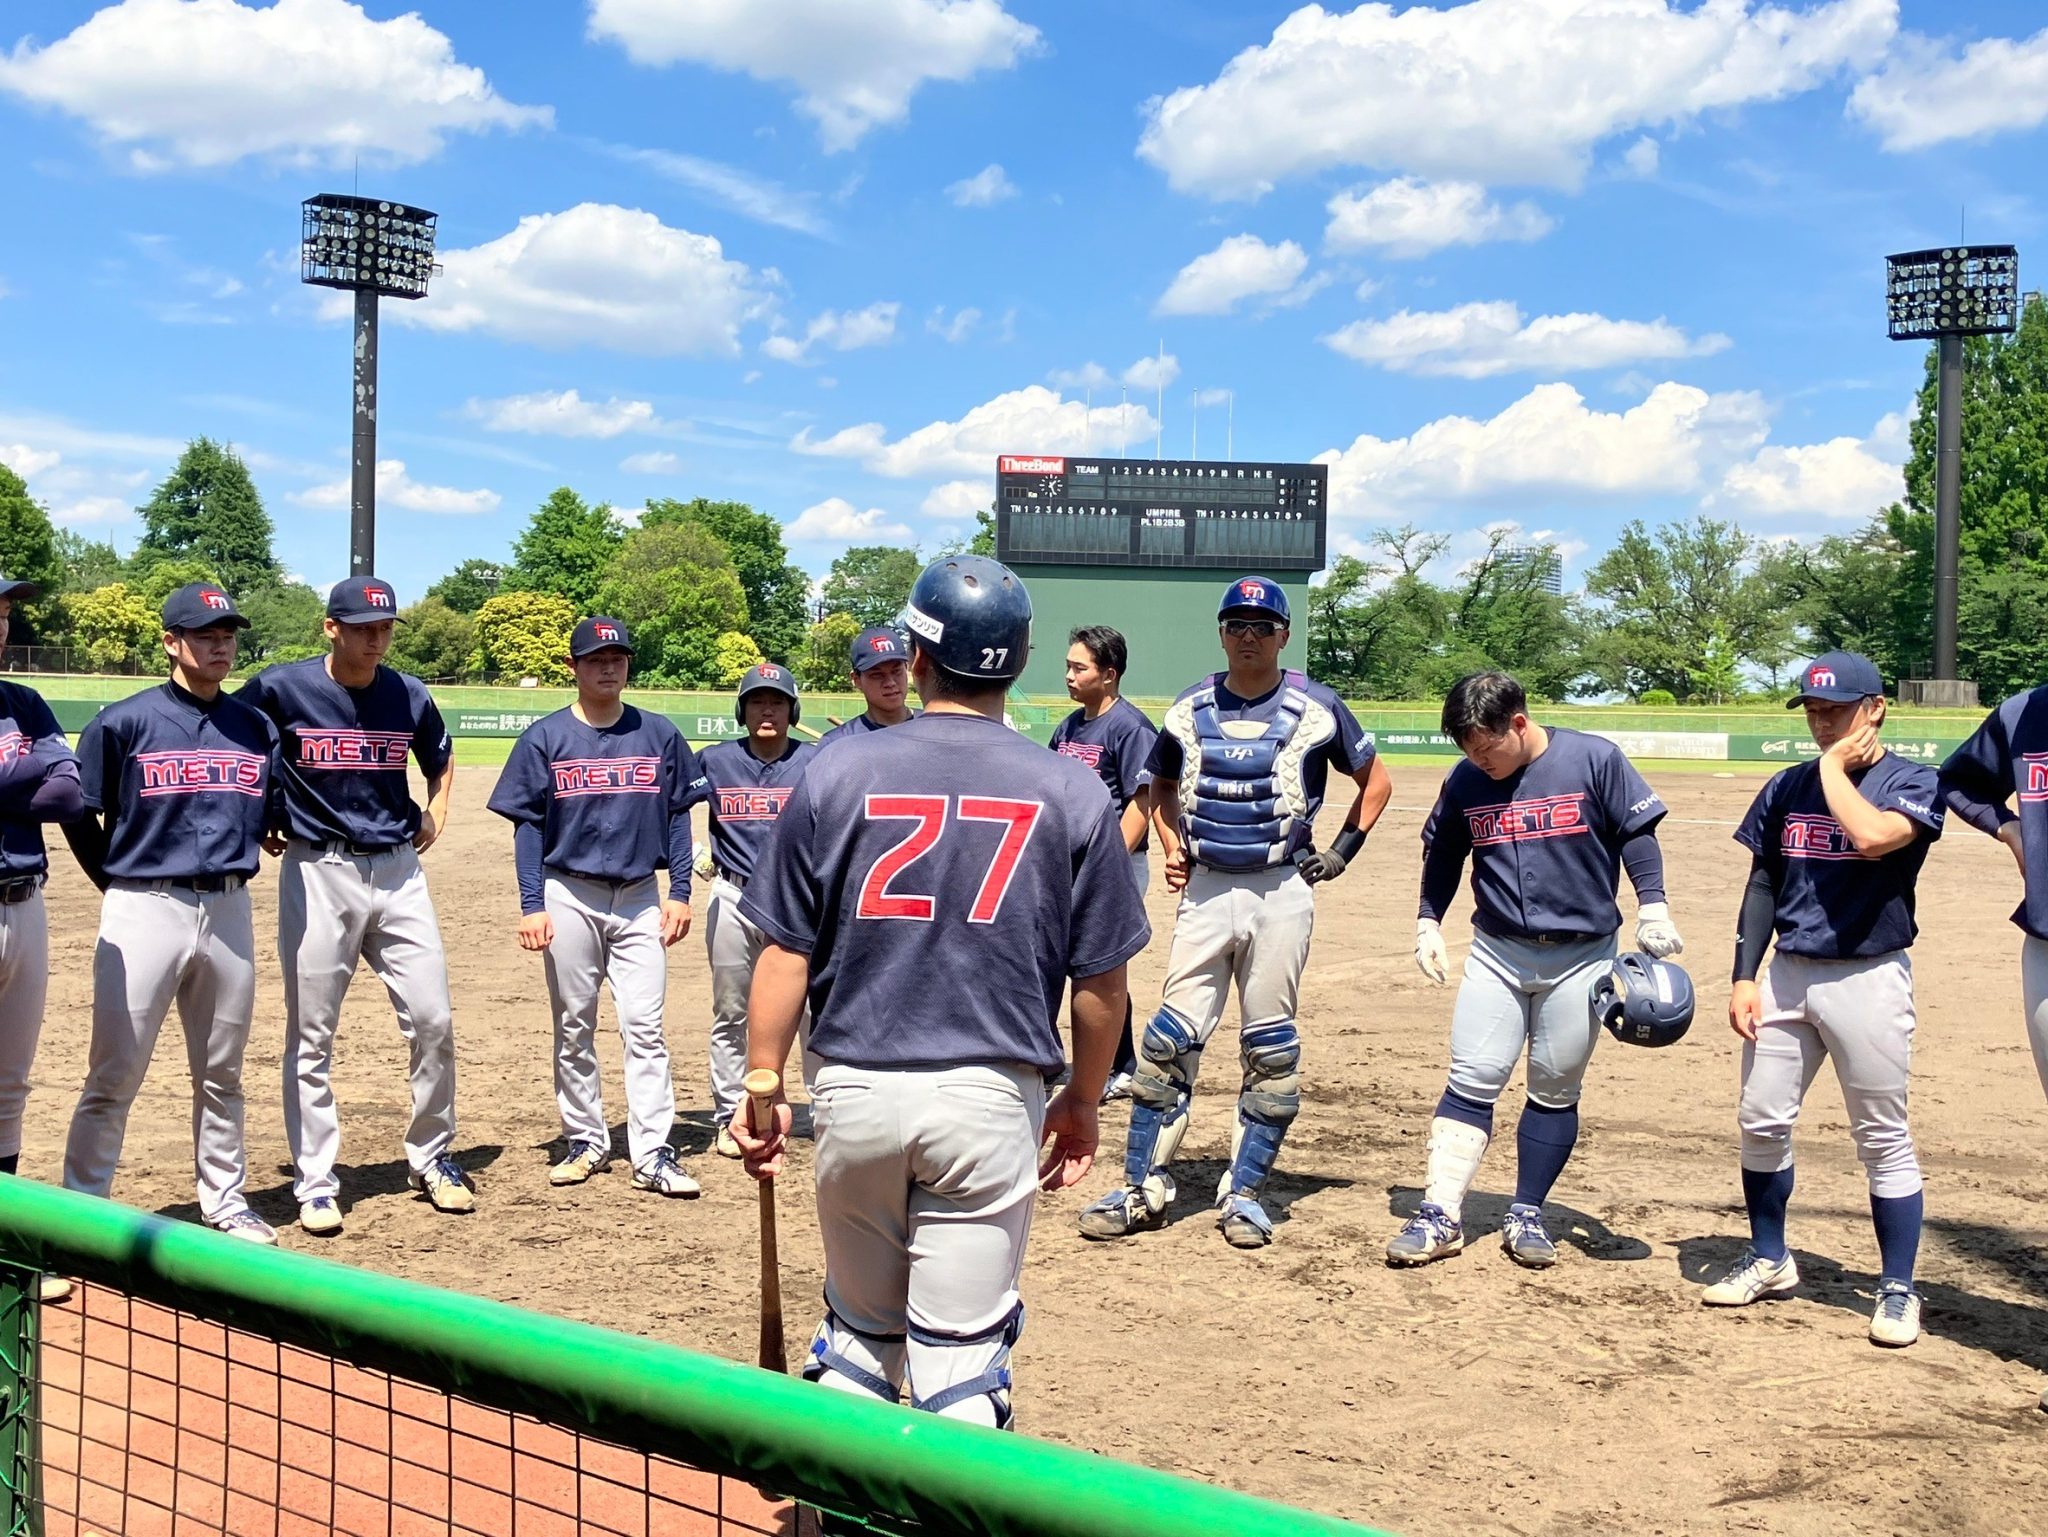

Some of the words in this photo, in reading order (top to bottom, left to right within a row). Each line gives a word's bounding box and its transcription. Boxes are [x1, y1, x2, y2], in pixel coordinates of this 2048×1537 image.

[1002, 458, 1063, 472] ThreeBond
[1075, 465, 1099, 474] TEAM
[1124, 467, 1129, 475] 2
[1136, 467, 1142, 475] 3
[1161, 468, 1166, 476] 5
[1173, 468, 1179, 476] 6
[1185, 469, 1191, 477] 7
[1197, 469, 1203, 477] 8
[1209, 469, 1215, 477] 9
[1238, 470, 1244, 478] R
[1254, 470, 1260, 478] H
[1266, 471, 1272, 479] E
[1024, 505, 1028, 513] 1
[1056, 506, 1062, 514] 4
[1079, 507, 1084, 515] 6
[1090, 507, 1095, 515] 7
[1100, 507, 1106, 515] 8
[1146, 508, 1180, 518] UMPIRE
[1210, 510, 1214, 518] 1
[1220, 510, 1226, 518] 2
[1241, 511, 1247, 519] 4
[1252, 511, 1258, 519] 5
[1263, 511, 1269, 519] 6
[1285, 512, 1291, 520] 8
[1296, 512, 1302, 520] 9
[980, 647, 1008, 669] 27
[697, 717, 747, 735] 日本工
[302, 737, 408, 762] METS
[143, 759, 260, 787] METS
[555, 764, 656, 790] METS
[721, 794, 790, 814] MET
[1470, 801, 1581, 838] METS
[1781, 822, 1858, 851] MET
[856, 794, 1045, 924] 27
